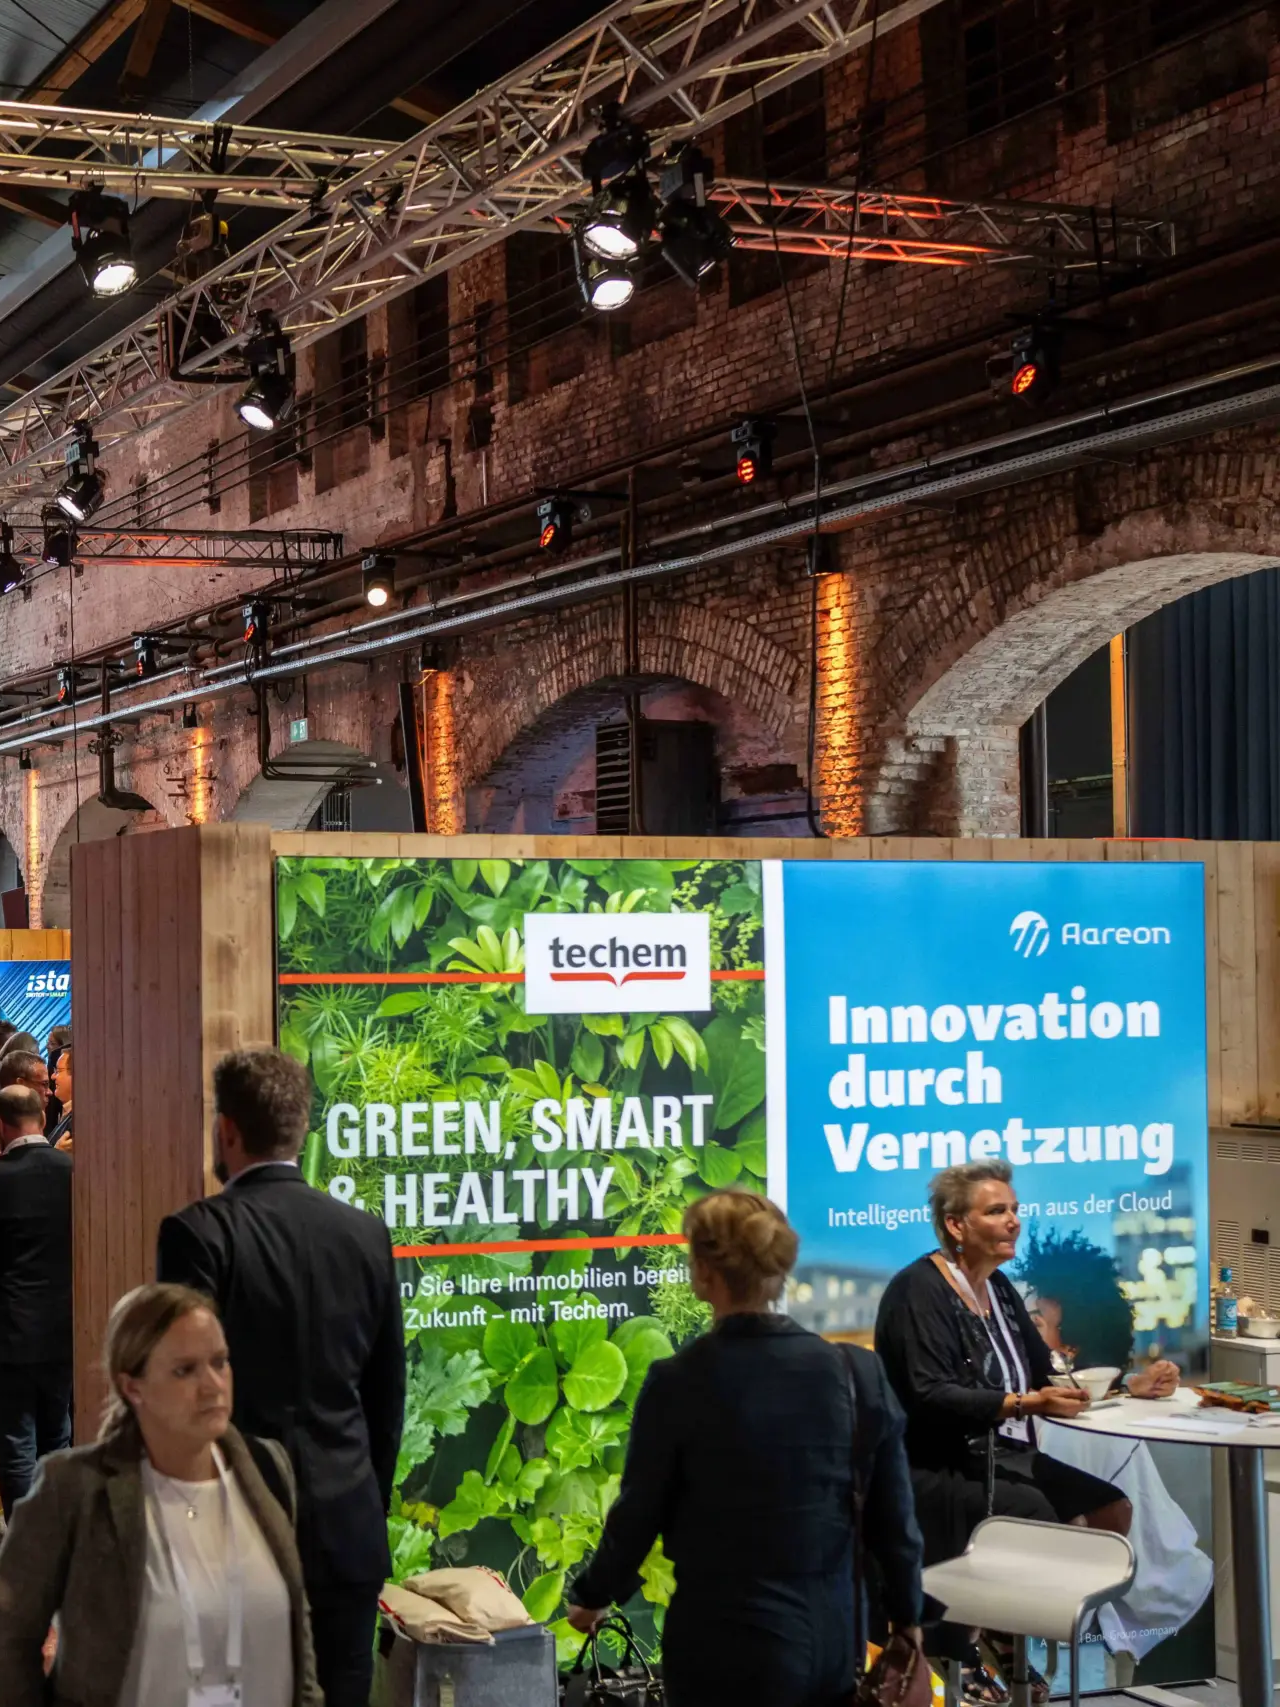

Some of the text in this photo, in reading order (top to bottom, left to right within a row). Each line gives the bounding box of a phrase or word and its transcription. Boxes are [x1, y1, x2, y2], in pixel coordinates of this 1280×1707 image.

[1061, 922, 1170, 946] Aareon
[549, 936, 687, 969] techem
[27, 970, 70, 991] ista
[829, 986, 1160, 1044] Innovation
[828, 1051, 1003, 1109] durch
[326, 1095, 713, 1161] GREEN, SMART
[824, 1118, 1174, 1176] Vernetzung
[384, 1167, 615, 1227] HEALTHY
[1046, 1201, 1078, 1215] aus
[1084, 1197, 1115, 1213] der
[1119, 1190, 1172, 1211] Cloud
[420, 1275, 454, 1297] Sie
[462, 1273, 502, 1295] Ihre
[509, 1267, 626, 1292] Immobilien
[404, 1305, 487, 1330] Zukunft
[510, 1302, 545, 1323] mit
[549, 1299, 635, 1321] Techem.
[1109, 1629, 1136, 1641] Group
[1140, 1626, 1180, 1637] company
